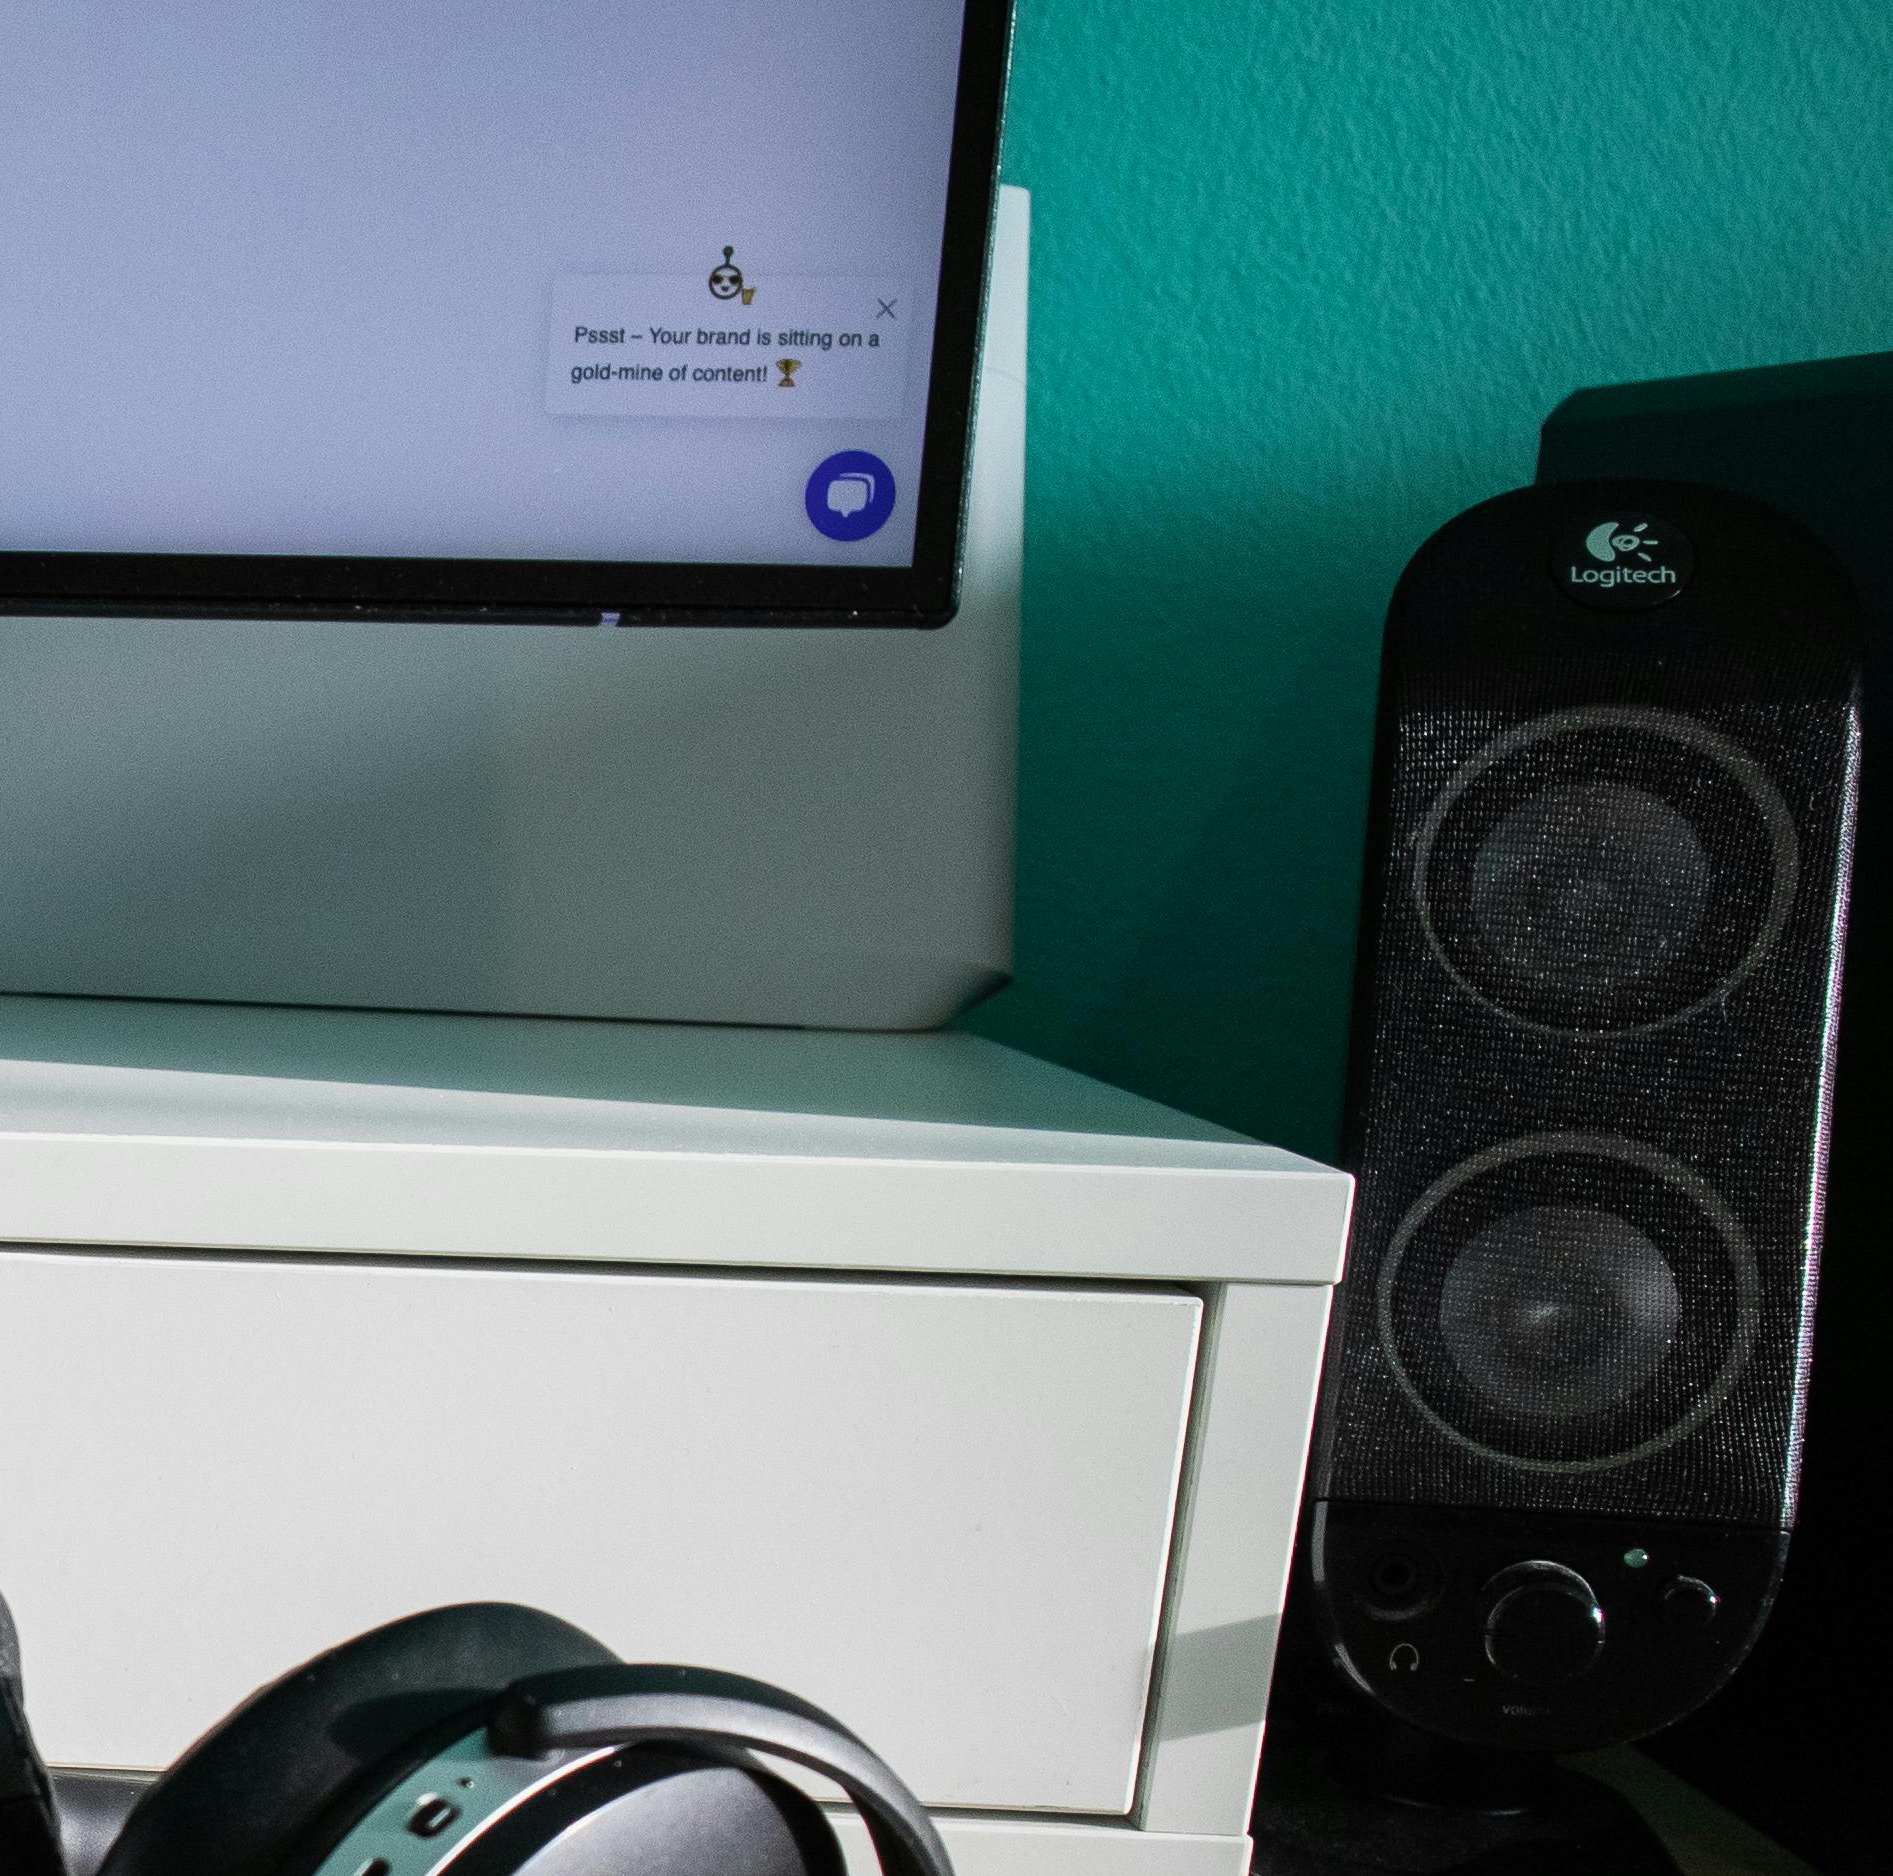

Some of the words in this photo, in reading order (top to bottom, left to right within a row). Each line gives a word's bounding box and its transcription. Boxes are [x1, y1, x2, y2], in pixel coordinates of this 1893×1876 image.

[574, 326, 626, 345] Pssst
[649, 327, 692, 345] Your
[696, 328, 751, 346] brand
[756, 329, 772, 347] is
[777, 330, 833, 352] sitting
[838, 334, 863, 348] on
[868, 334, 881, 348] a
[570, 363, 663, 385] gold-mine
[668, 363, 688, 381] of
[692, 365, 768, 384] content!
[1570, 565, 1677, 589] Logitech
